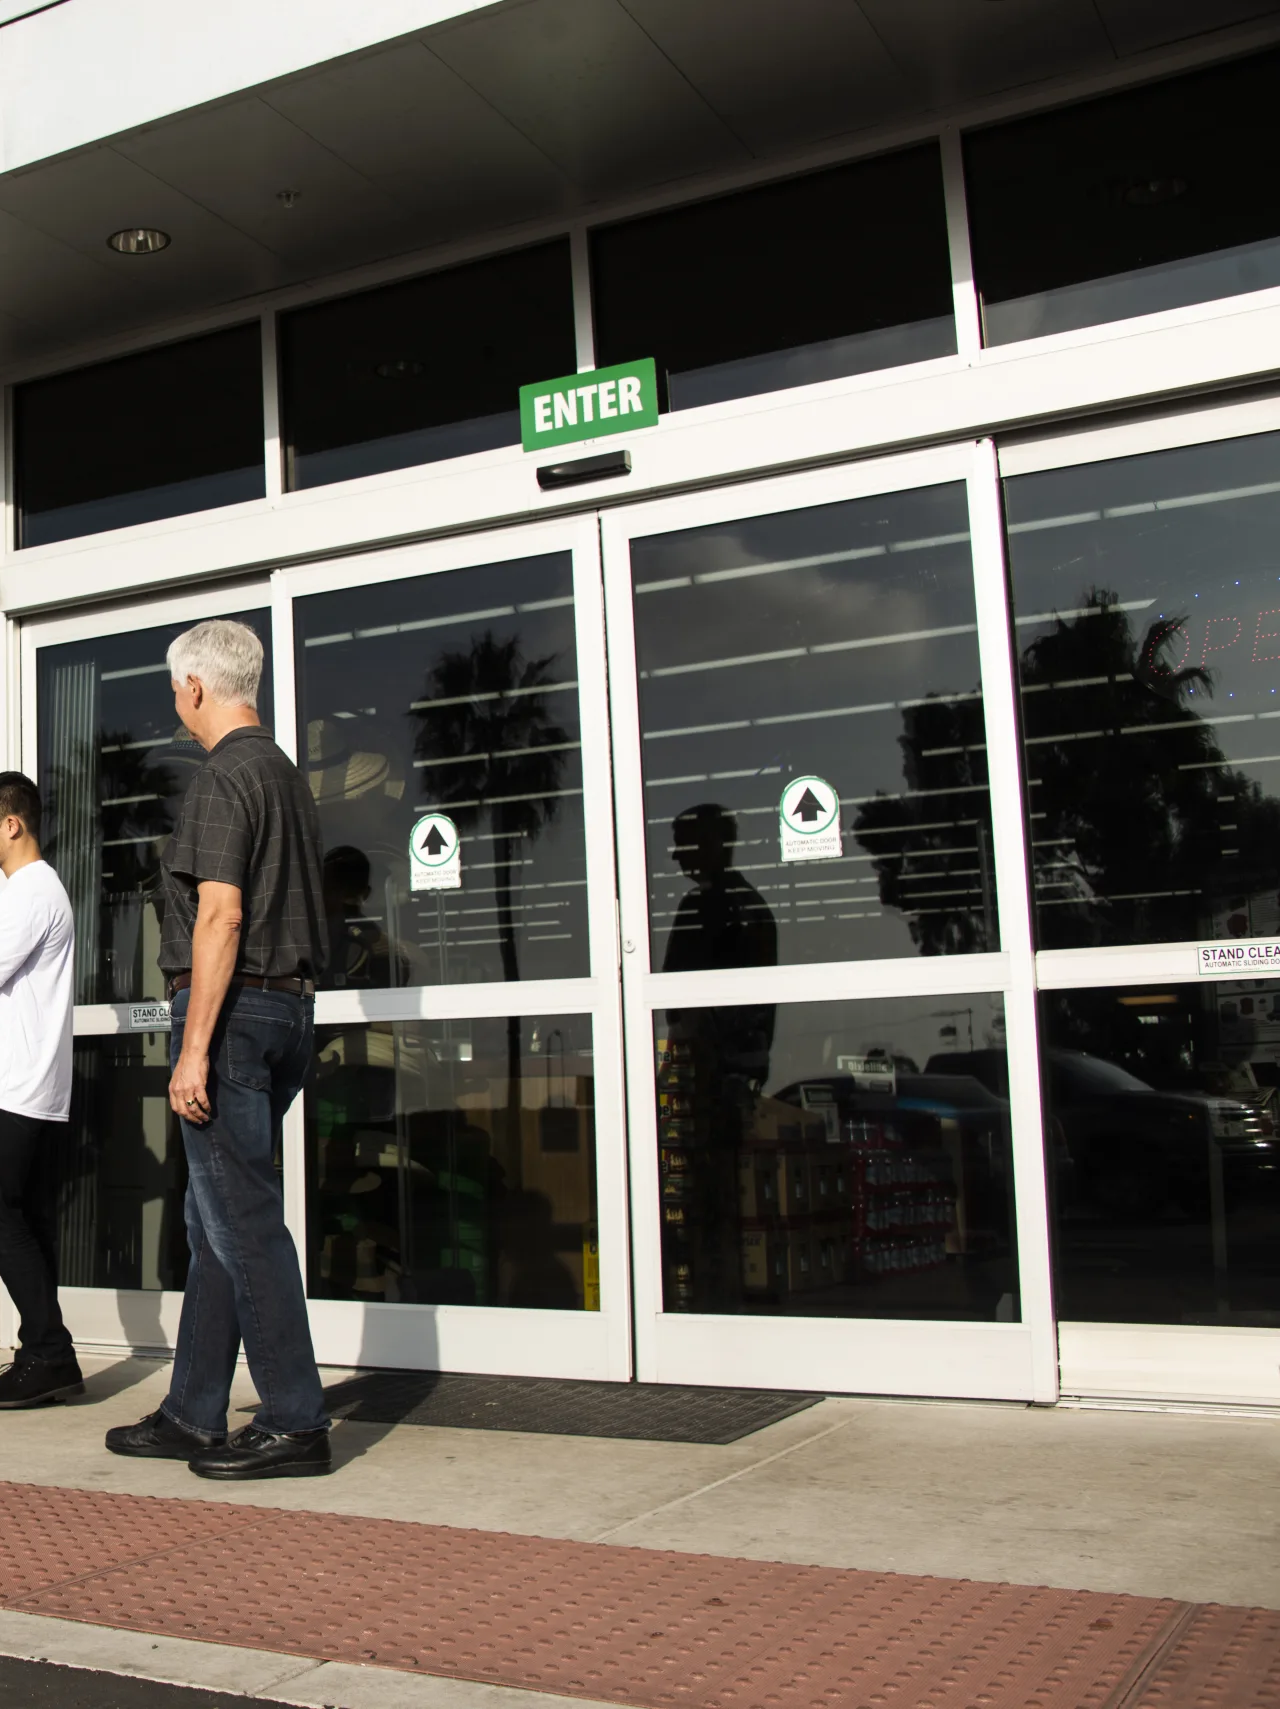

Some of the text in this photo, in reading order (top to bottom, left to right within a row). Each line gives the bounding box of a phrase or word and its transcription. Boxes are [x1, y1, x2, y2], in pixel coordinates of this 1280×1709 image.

[533, 376, 643, 433] ENTER
[786, 838, 818, 846] AUTOMATIC
[1202, 948, 1245, 961] STAND
[1205, 960, 1242, 968] AUTOMATIC
[132, 1007, 170, 1018] STAND CL
